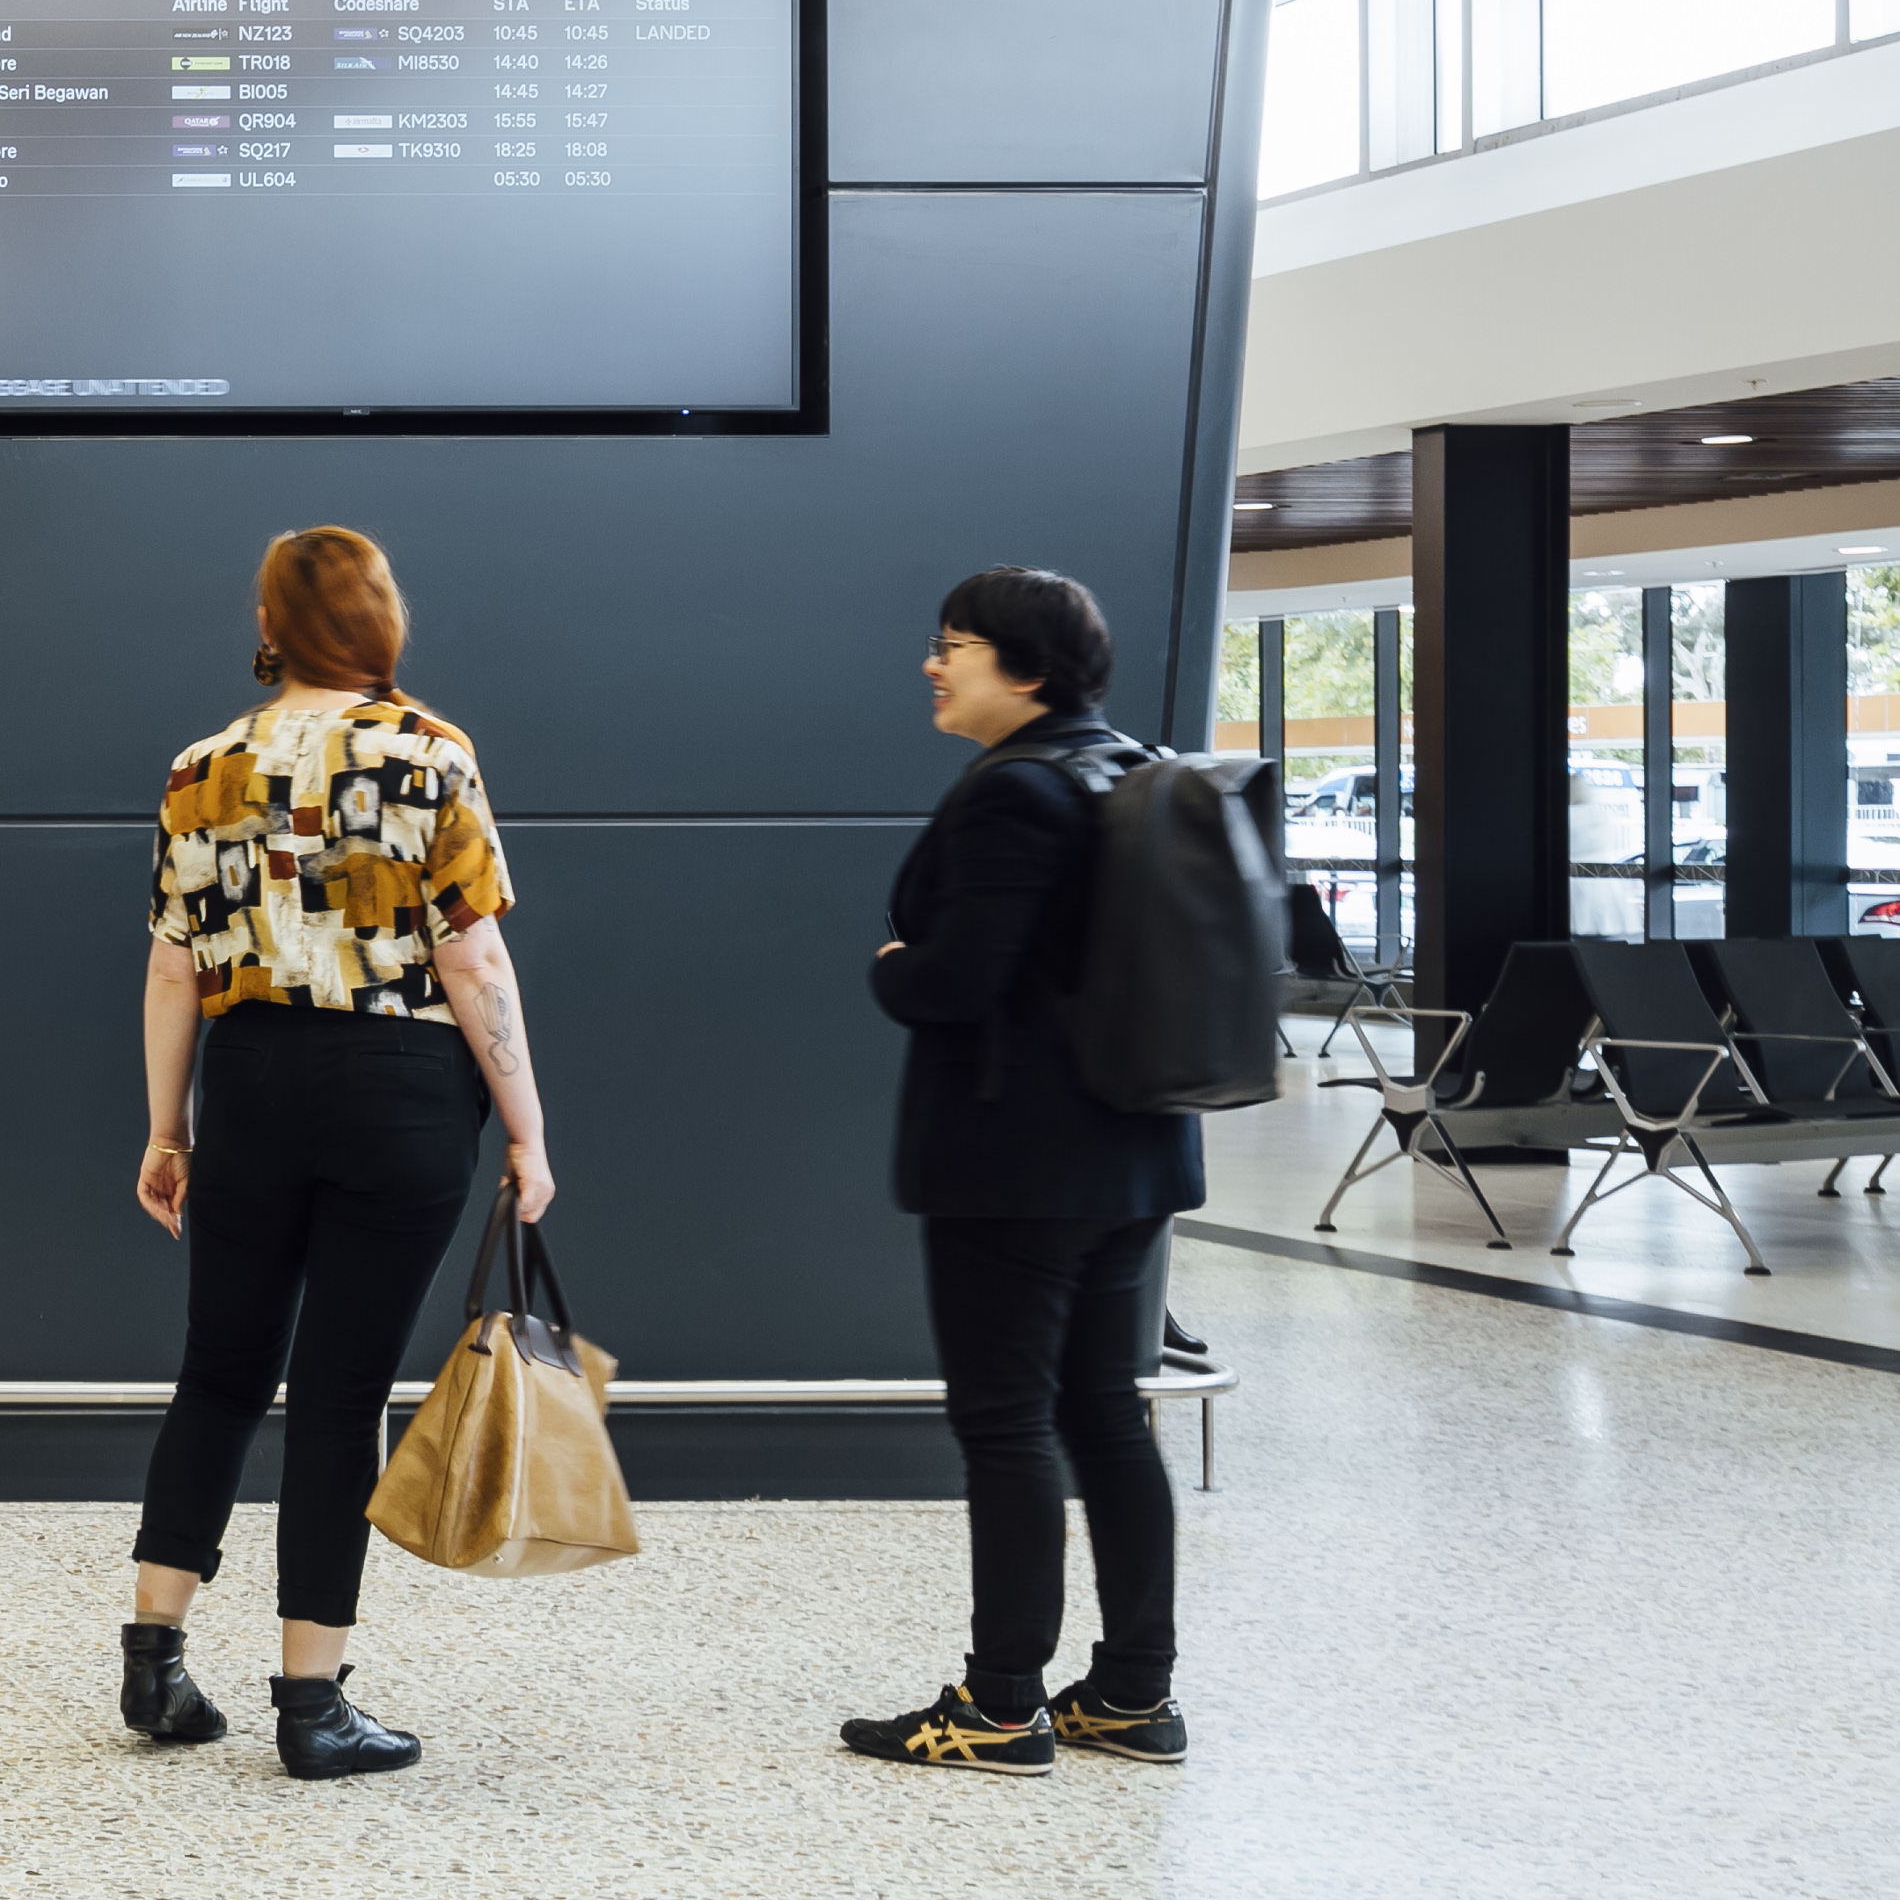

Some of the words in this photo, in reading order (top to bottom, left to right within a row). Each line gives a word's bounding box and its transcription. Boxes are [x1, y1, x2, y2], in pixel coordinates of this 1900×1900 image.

[238, 25, 293, 41] NZ123
[398, 25, 465, 44] SQ4203
[493, 25, 538, 41] 10:45
[564, 25, 609, 41] 10:45
[635, 25, 711, 40] LANDED
[238, 55, 291, 70] TR018
[398, 55, 460, 70] MI8530
[493, 54, 539, 70] 14:40
[564, 54, 608, 70] 14:26
[34, 84, 109, 103] Begawan
[238, 84, 288, 100] BI005
[493, 83, 539, 99] 14:45
[564, 83, 608, 99] 14:27
[184, 117, 209, 126] QATAR
[238, 113, 297, 132] QR904
[398, 113, 468, 129] KM2303
[493, 112, 537, 128] 15:55
[564, 112, 608, 128] 15:47
[238, 142, 291, 161] SQ217
[398, 142, 461, 158] TK9310
[493, 142, 536, 157] 18:25
[564, 142, 608, 157] 18:08
[238, 171, 297, 187] UL604
[493, 171, 541, 187] 05:30
[564, 171, 612, 187] 05:30
